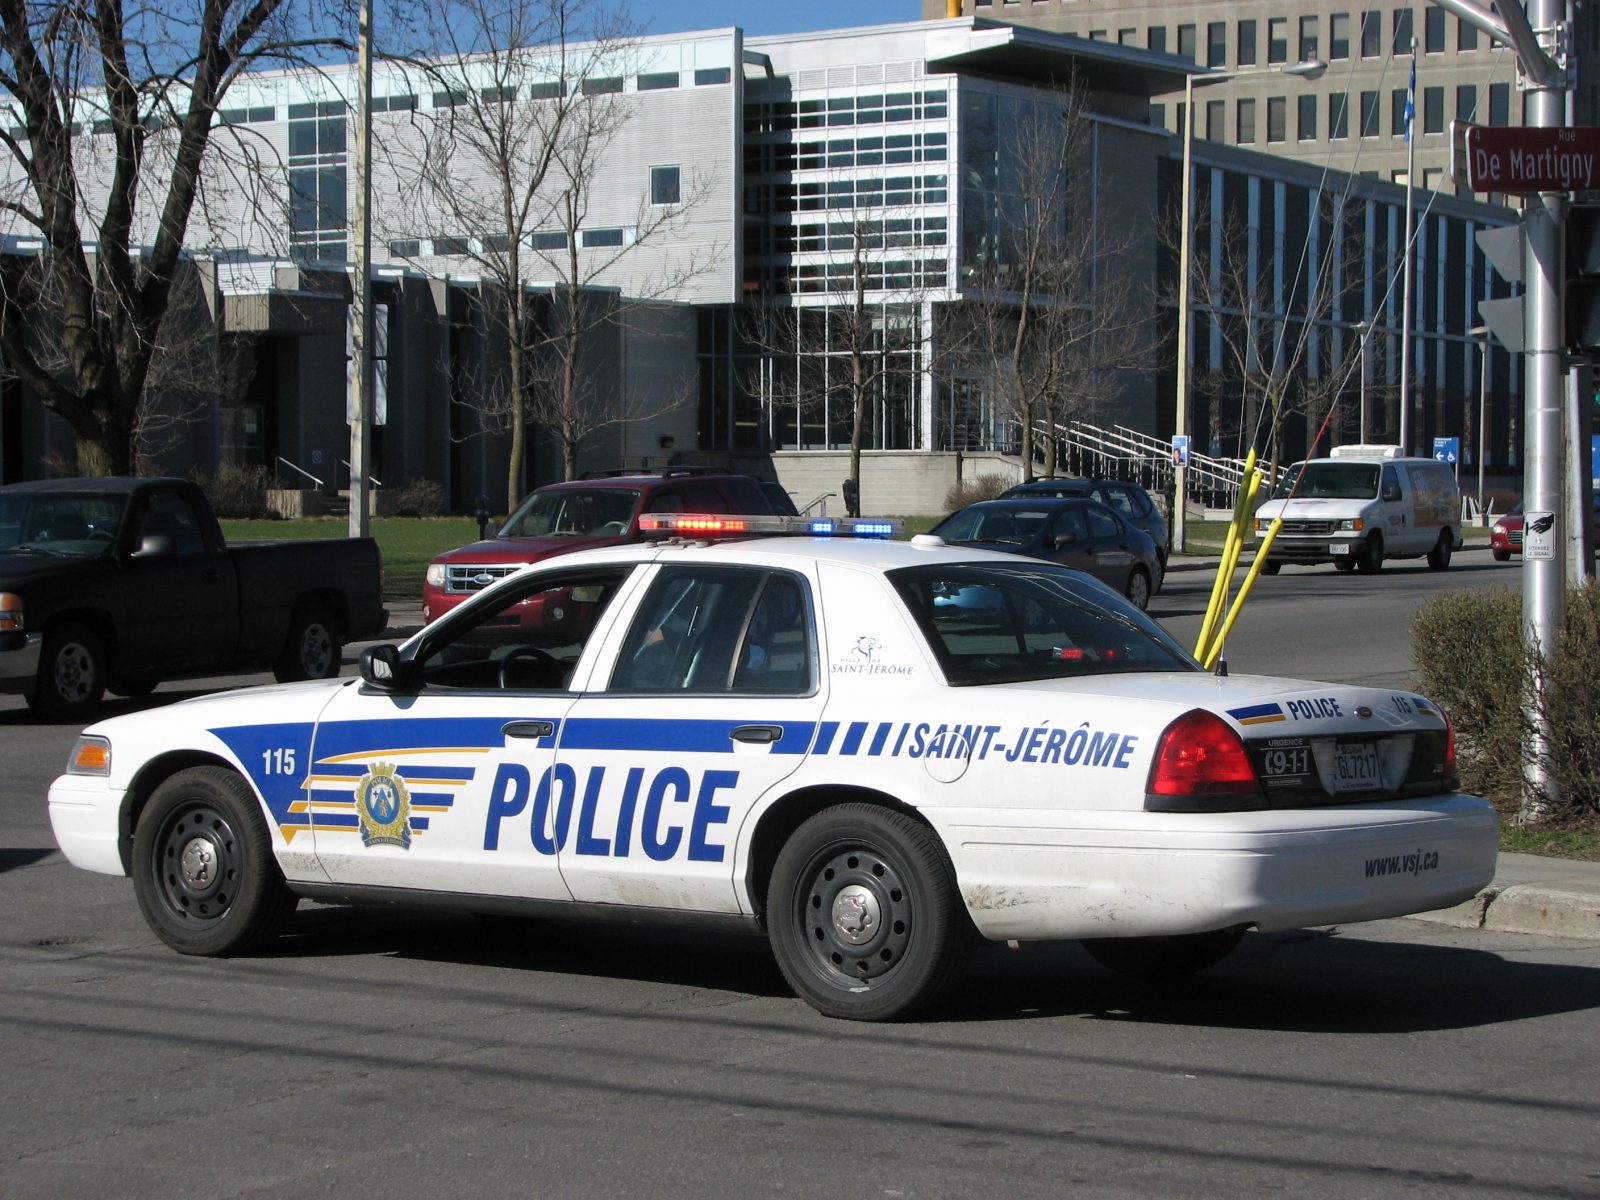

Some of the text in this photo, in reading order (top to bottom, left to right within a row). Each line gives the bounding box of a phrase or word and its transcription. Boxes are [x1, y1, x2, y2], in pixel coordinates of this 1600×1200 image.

[1558, 129, 1576, 142] Rue
[1476, 145, 1593, 188] De Martigny
[831, 663, 914, 676] SAINT-JÉRÔME
[1286, 698, 1343, 721] POLICE
[1391, 696, 1413, 714] 115
[908, 719, 1139, 769] SAINT-JÉRÔME
[1268, 738, 1304, 747] URGENCE
[262, 748, 295, 775] 115
[1334, 754, 1376, 780] GL7217
[483, 763, 740, 862] POLICE
[1365, 849, 1438, 877] www.vsj.ca
